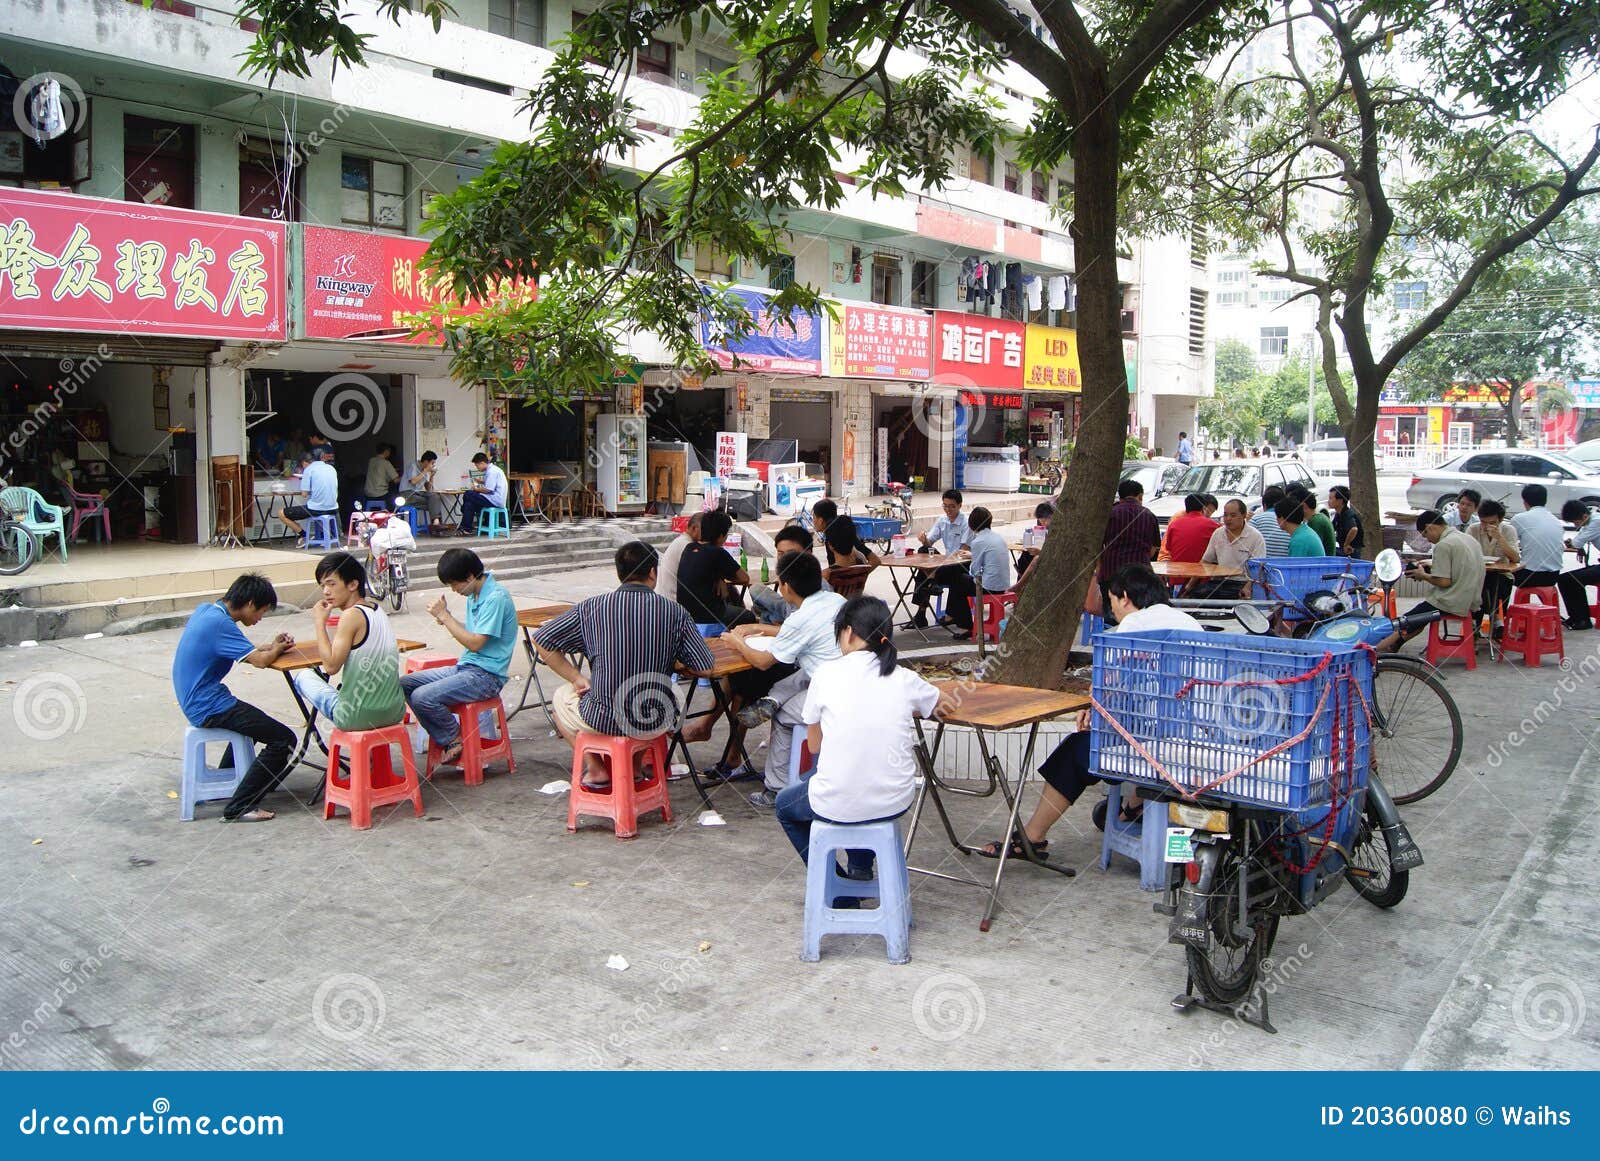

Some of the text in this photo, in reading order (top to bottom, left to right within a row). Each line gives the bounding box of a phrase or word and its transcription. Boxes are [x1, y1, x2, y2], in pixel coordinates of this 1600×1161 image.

[316, 276, 375, 297] Kingway
[848, 311, 929, 339] 办理车辆违章
[1045, 338, 1068, 357] LED
